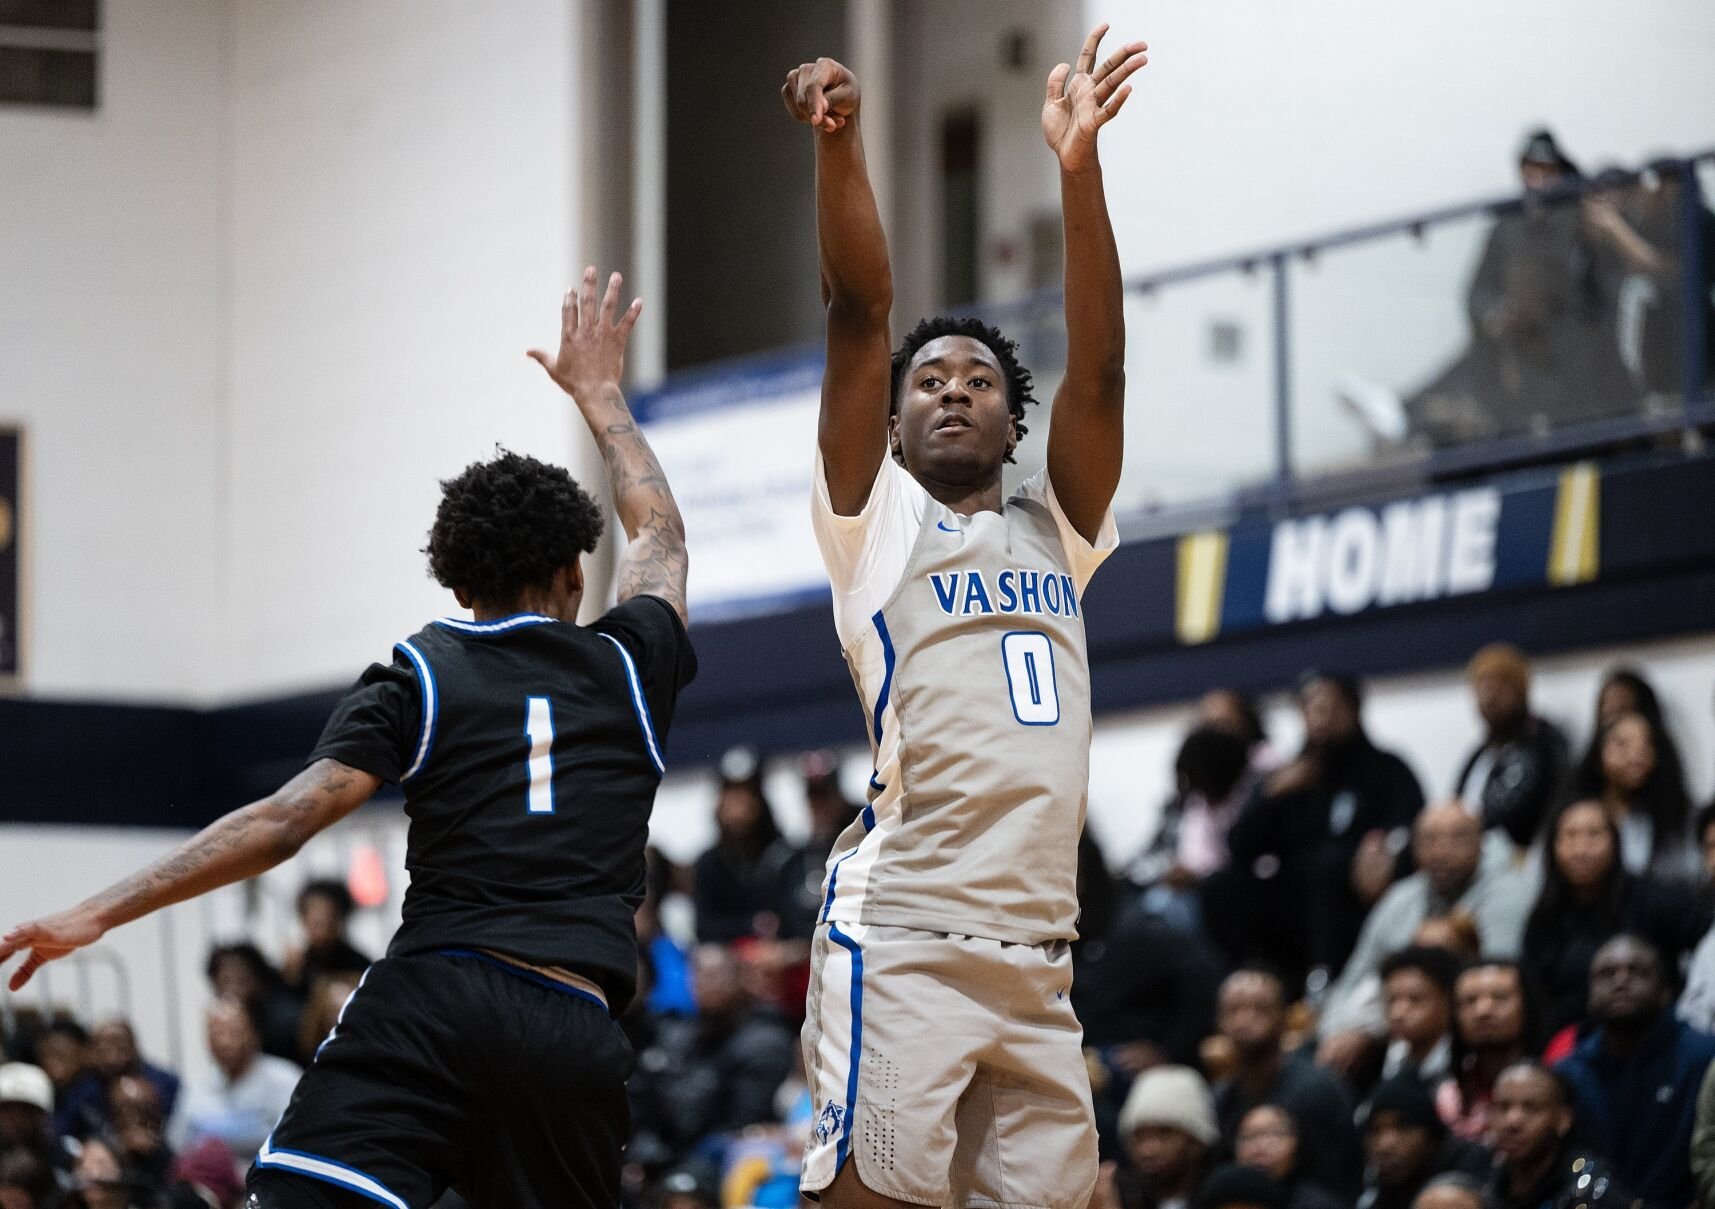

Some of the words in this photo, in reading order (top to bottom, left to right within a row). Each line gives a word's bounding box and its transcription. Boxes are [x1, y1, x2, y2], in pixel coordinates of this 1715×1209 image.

[928, 569, 1079, 620] VASHON
[1265, 487, 1499, 623] HOME
[1002, 631, 1060, 726] 0
[524, 695, 556, 815] 1
